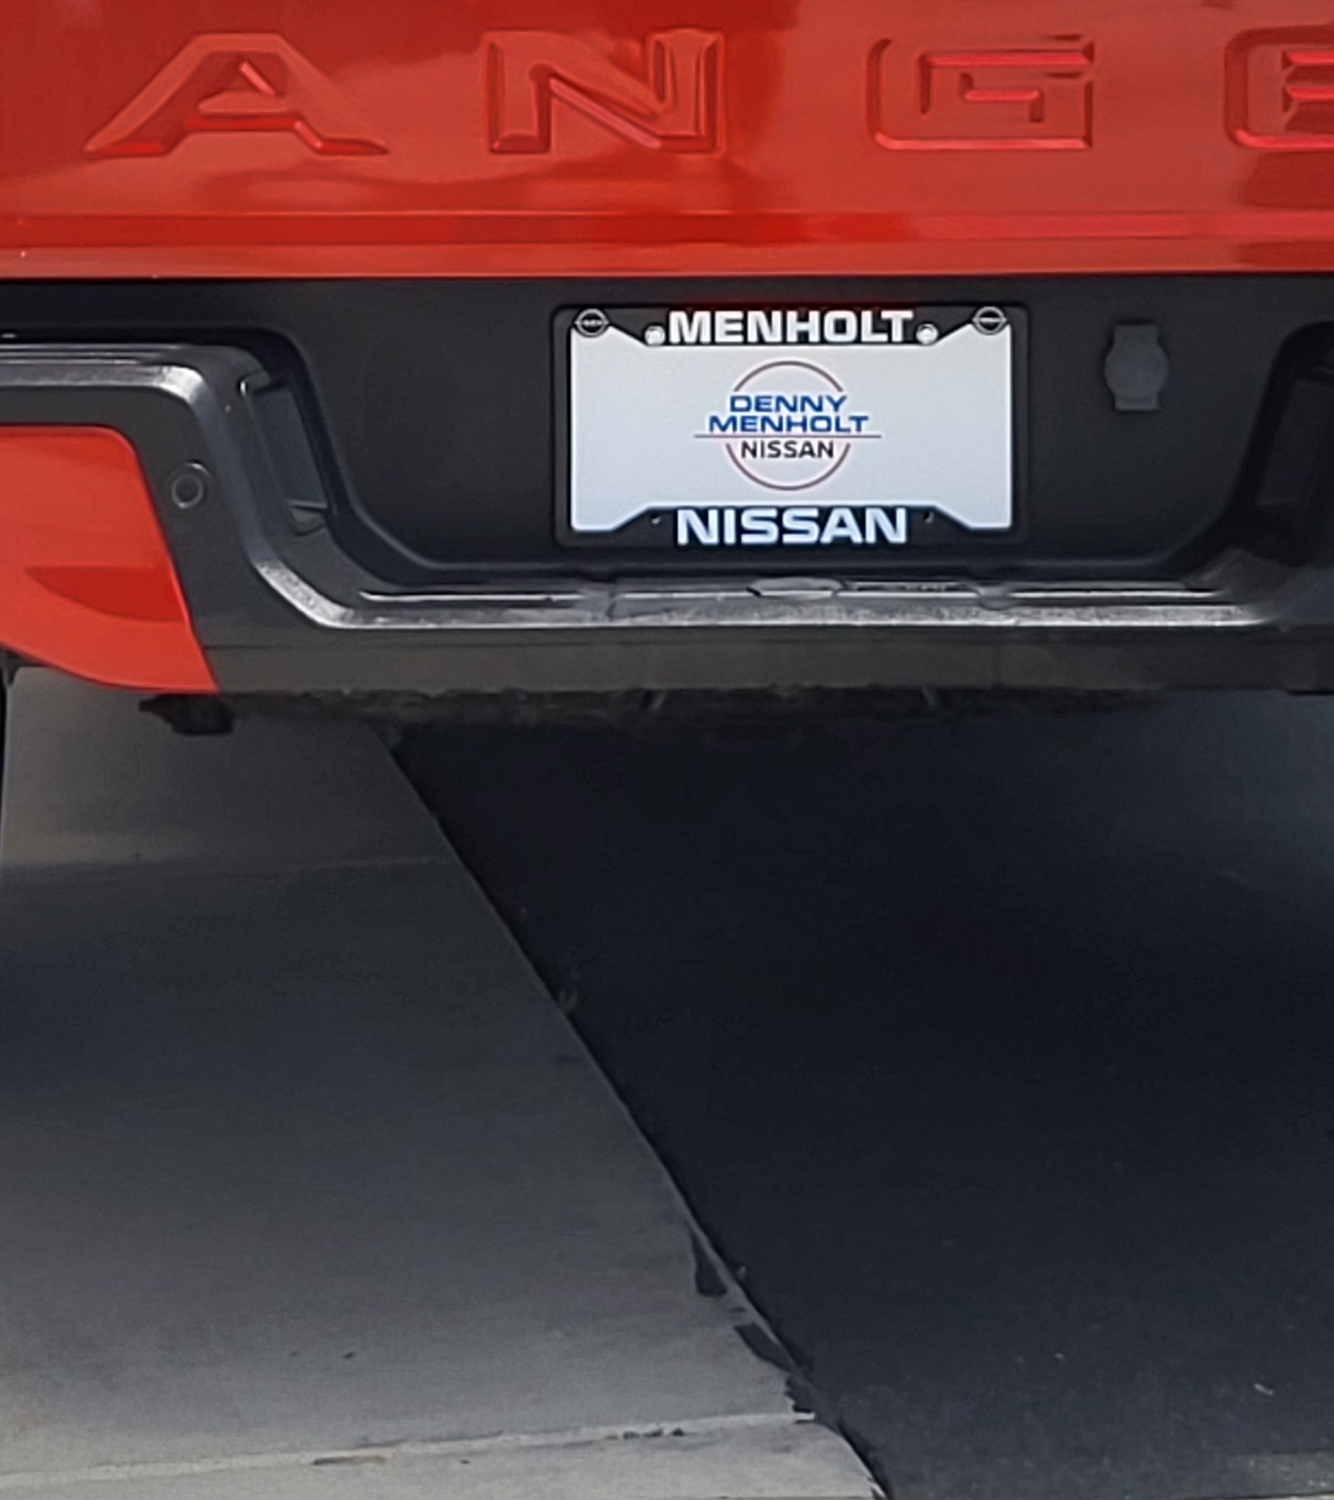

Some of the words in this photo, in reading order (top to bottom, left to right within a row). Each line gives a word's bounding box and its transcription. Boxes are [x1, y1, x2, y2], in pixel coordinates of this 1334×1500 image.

[668, 310, 914, 343] MENHOLT
[729, 395, 848, 413] DENNY
[708, 415, 870, 433] MENHOLT
[740, 440, 835, 459] NISSAN
[676, 507, 908, 545] NISSAN
